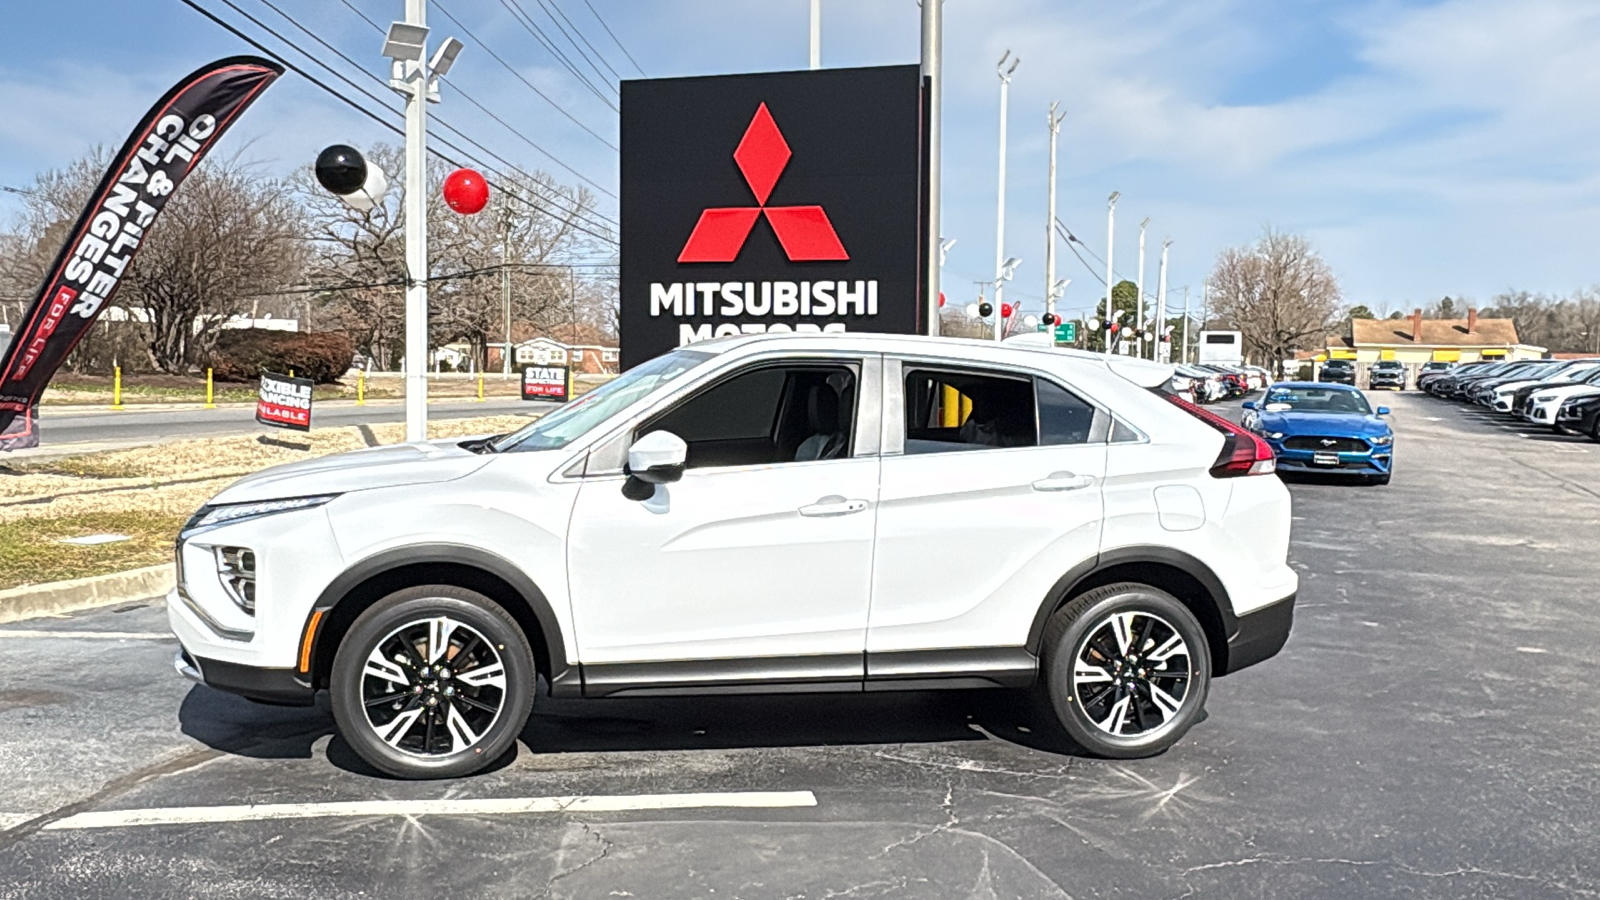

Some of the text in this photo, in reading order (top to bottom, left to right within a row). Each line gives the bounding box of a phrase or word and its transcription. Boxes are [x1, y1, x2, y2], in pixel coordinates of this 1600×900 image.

[65, 114, 184, 284] CHANGES
[70, 114, 216, 319] OIL & FILTER
[17, 292, 71, 376] FOR LIFE
[650, 280, 878, 316] MITSUBISHI
[525, 367, 565, 379] STATE
